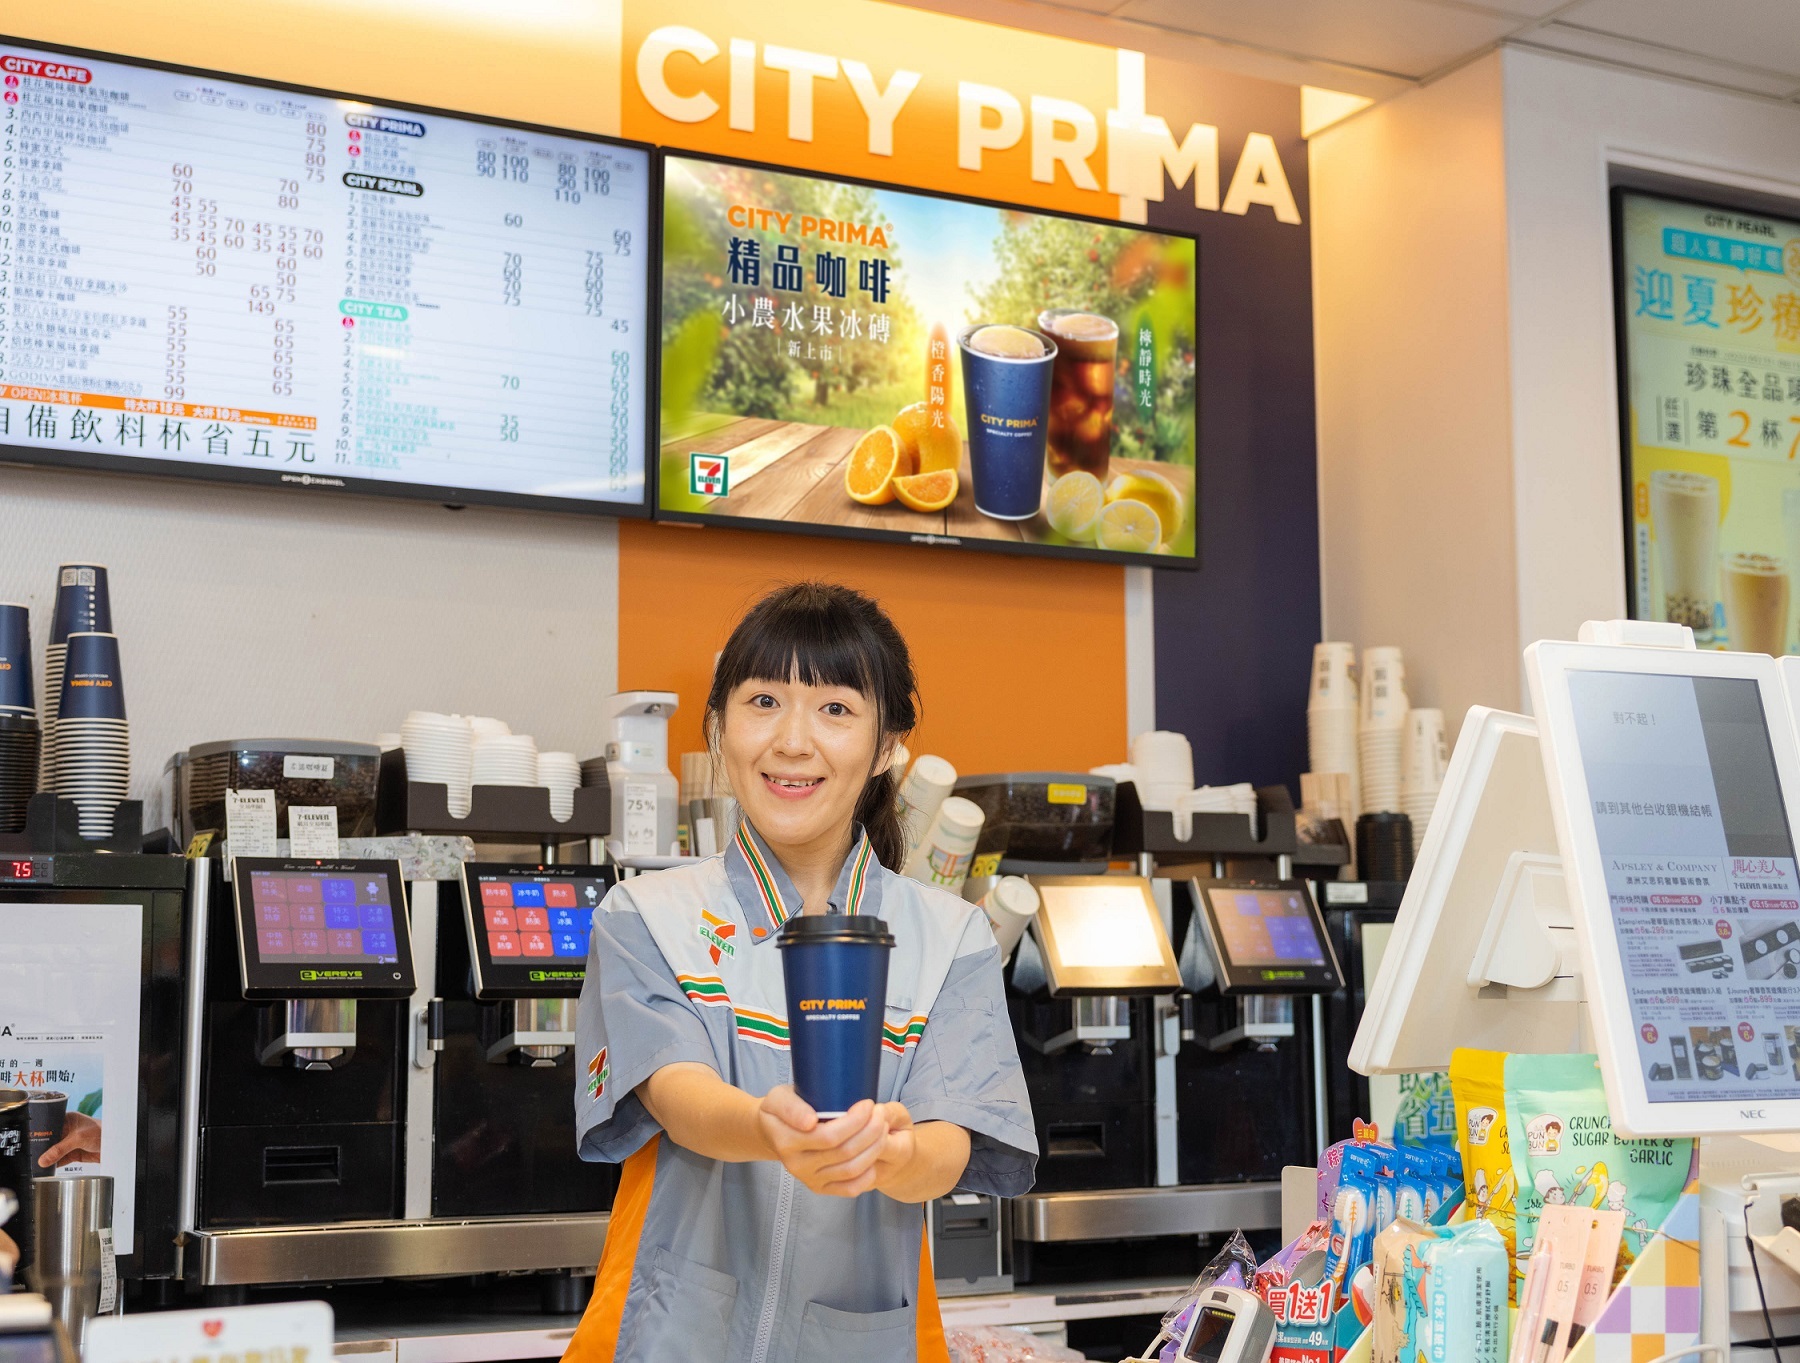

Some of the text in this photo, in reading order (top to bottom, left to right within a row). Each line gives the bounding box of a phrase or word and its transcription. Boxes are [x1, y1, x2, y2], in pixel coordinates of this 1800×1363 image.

[5, 58, 87, 82] CITY CAFE
[306, 122, 326, 137] 80
[346, 115, 422, 136] CITY PRIMA
[636, 24, 1302, 225] CITY PRIMA
[307, 137, 325, 153] 75
[305, 153, 325, 167] 80
[502, 154, 529, 170] 100
[584, 167, 610, 183] 100
[172, 163, 192, 178] 60
[279, 178, 299, 194] 70
[306, 168, 325, 183] 75
[502, 168, 529, 183] 110
[584, 181, 610, 196] 110
[172, 179, 192, 194] 70
[278, 194, 299, 210] 80
[346, 175, 420, 196] CITY PEARL
[171, 196, 217, 214] 45 55
[555, 189, 581, 205] 110
[171, 212, 190, 226] 45
[198, 214, 217, 230] 55
[224, 218, 245, 233] 70
[252, 223, 272, 238] 45
[278, 225, 297, 241] 55
[304, 228, 323, 244] 70
[504, 212, 523, 228] 60
[727, 205, 793, 234] CITY
[171, 227, 190, 242] 35
[197, 231, 216, 245] 45
[224, 234, 244, 249] 60
[252, 238, 271, 253] 35
[277, 242, 297, 256] 45
[303, 244, 323, 260] 60
[196, 246, 297, 272] 60 60
[504, 251, 522, 267] 70
[196, 261, 296, 287] 50 50
[727, 237, 891, 304] 精品咖啡
[250, 284, 295, 303] 65 75
[248, 300, 275, 316] 149
[377, 306, 403, 320] TEA
[168, 305, 294, 334] 55 65
[612, 319, 629, 333] 45
[721, 293, 891, 344] 小農水果冰磚
[167, 321, 187, 337] 55
[274, 334, 294, 350] 65
[167, 336, 293, 365] 55 65
[787, 340, 833, 361] 新上市
[166, 353, 293, 381] 55 65
[165, 369, 292, 397] 55 65
[501, 375, 520, 390] 70
[930, 340, 945, 429] 橙香陽光
[164, 385, 185, 400] 99
[500, 415, 519, 430] 35
[980, 413, 1038, 429] CITY PRIMA
[500, 428, 519, 442] 50
[1595, 801, 1713, 817] 請到其他台收銀機結帳
[700, 926, 735, 957] ELEVEN
[800, 998, 866, 1011] CITY PRIMA
[1740, 1109, 1766, 1118] NEC
[1528, 1132, 1545, 1140] PUN
[1528, 1141, 1545, 1149] BUN
[1572, 1132, 1609, 1146] SUGAR
[1630, 1149, 1673, 1166] GARLIC
[1557, 1280, 1569, 1292] 0.5
[1584, 1283, 1598, 1295] 0.5
[1269, 1282, 1331, 1320] 買1送1
